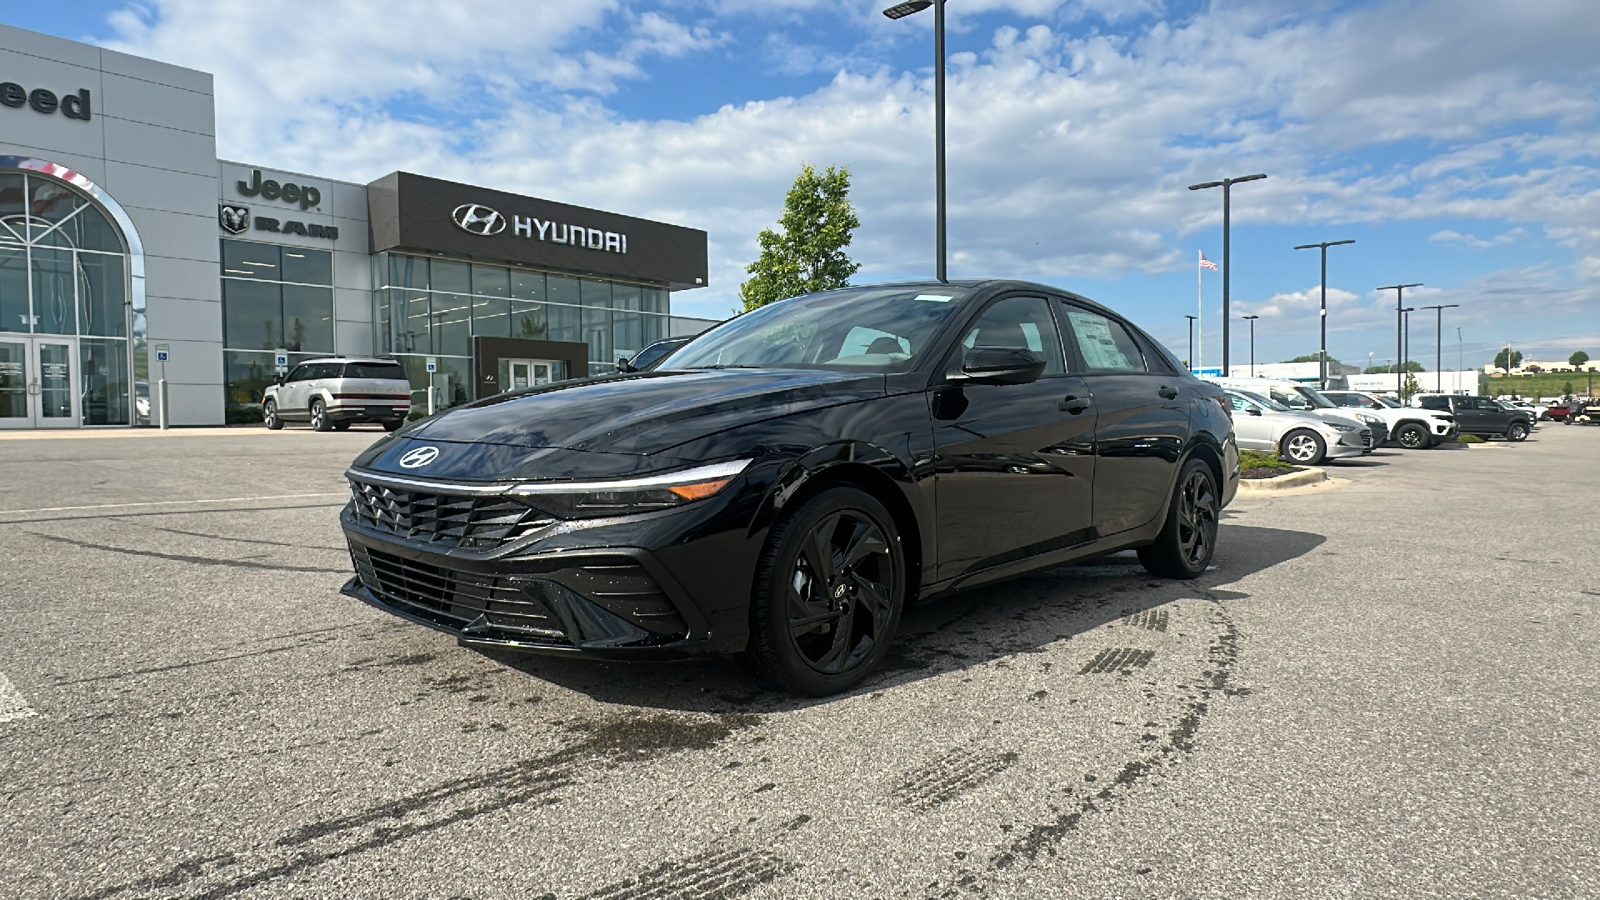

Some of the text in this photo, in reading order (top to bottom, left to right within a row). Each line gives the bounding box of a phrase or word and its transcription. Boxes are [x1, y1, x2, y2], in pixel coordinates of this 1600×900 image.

[237, 169, 321, 211] Jeep
[255, 216, 339, 240] RAM
[513, 214, 628, 254] HYUNDAI
